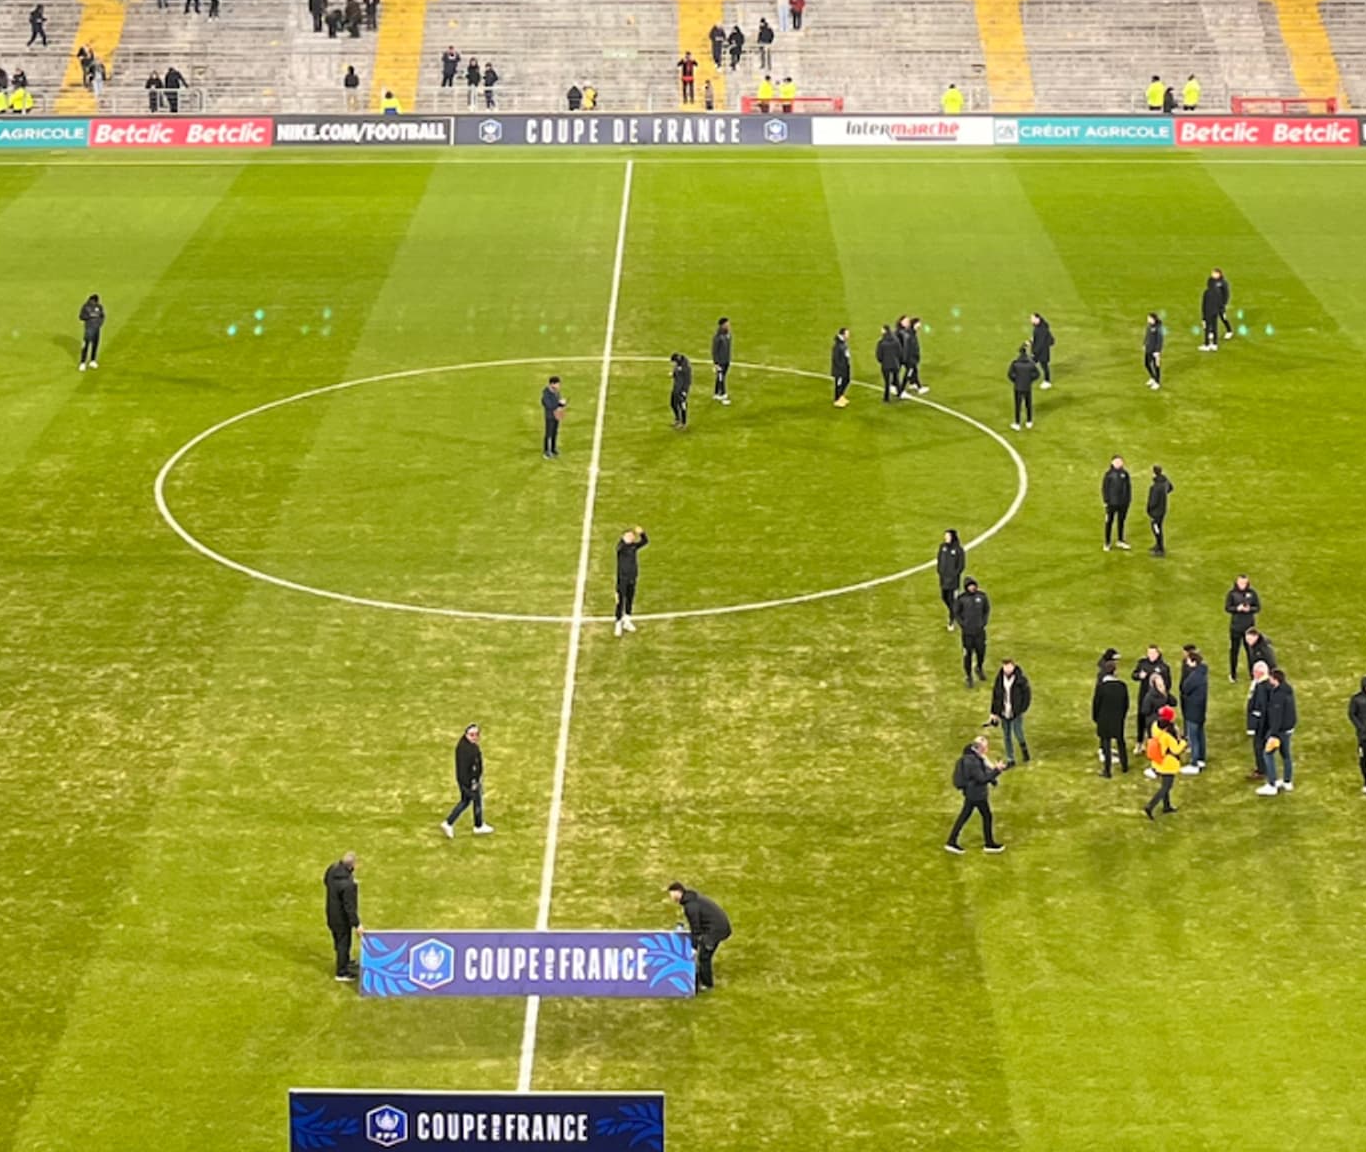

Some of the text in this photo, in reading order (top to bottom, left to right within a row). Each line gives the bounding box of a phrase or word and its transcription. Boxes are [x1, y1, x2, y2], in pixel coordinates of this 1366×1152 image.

[0, 126, 86, 141] AGRICOLE
[94, 122, 265, 143] Betclic Betclic
[275, 123, 446, 142] NIKE.COM/FOOTBALL
[525, 119, 741, 144] COUPE DE FRANCE
[1019, 123, 1082, 138] CRÉDIT
[1084, 125, 1169, 139] AGRICOLE
[1180, 122, 1351, 143] Betclic Betclic
[464, 947, 540, 982] COUPE
[559, 947, 648, 981] FRANCE
[416, 1114, 488, 1142] COUPE
[505, 1114, 588, 1142] FRANCE
